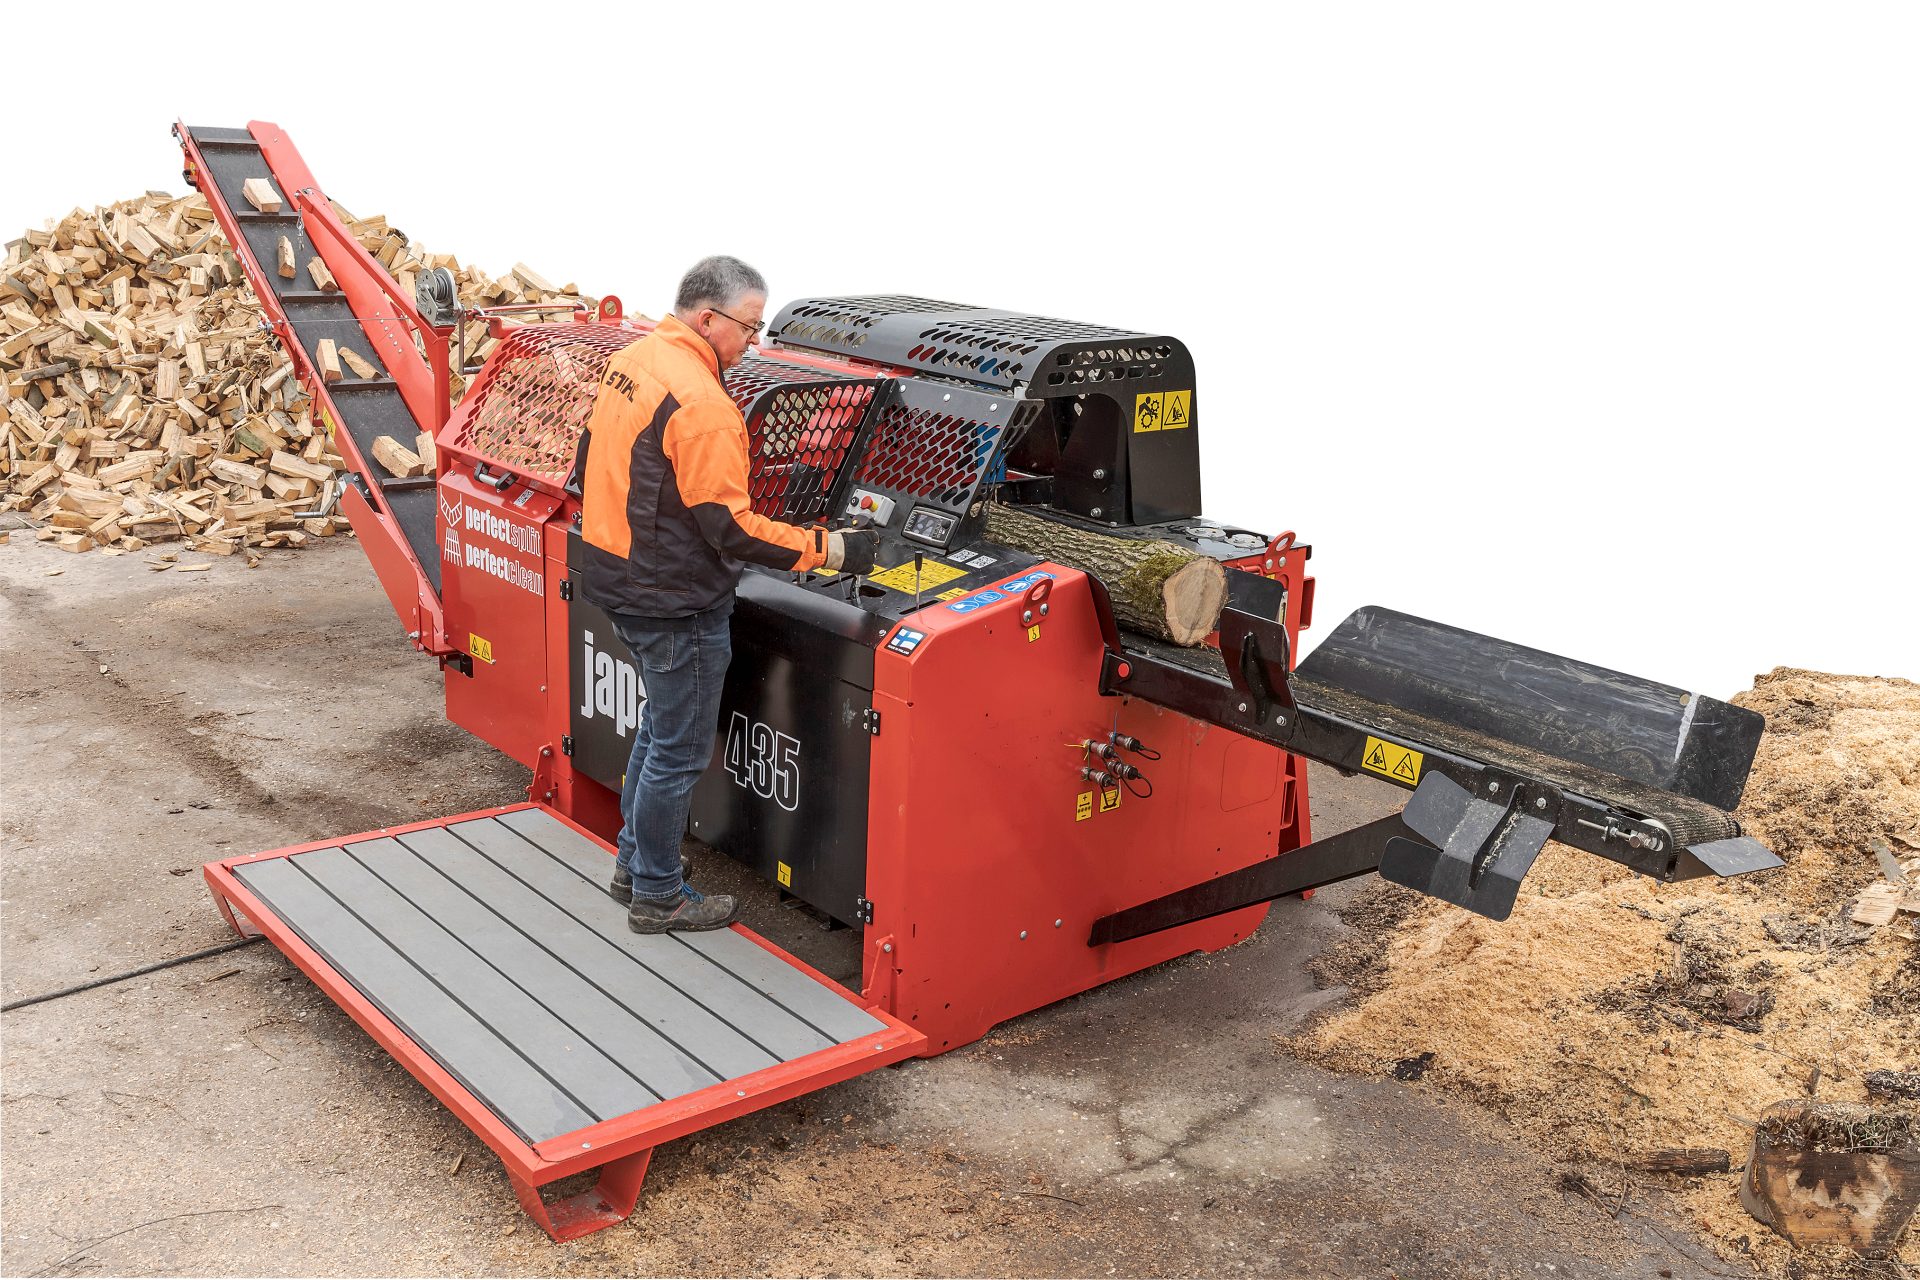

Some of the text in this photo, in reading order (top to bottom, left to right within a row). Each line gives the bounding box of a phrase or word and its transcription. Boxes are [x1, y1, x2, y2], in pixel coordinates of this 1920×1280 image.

[465, 505, 541, 557] perfectsplit
[465, 543, 544, 597] perfectclean
[724, 710, 801, 812] 435
